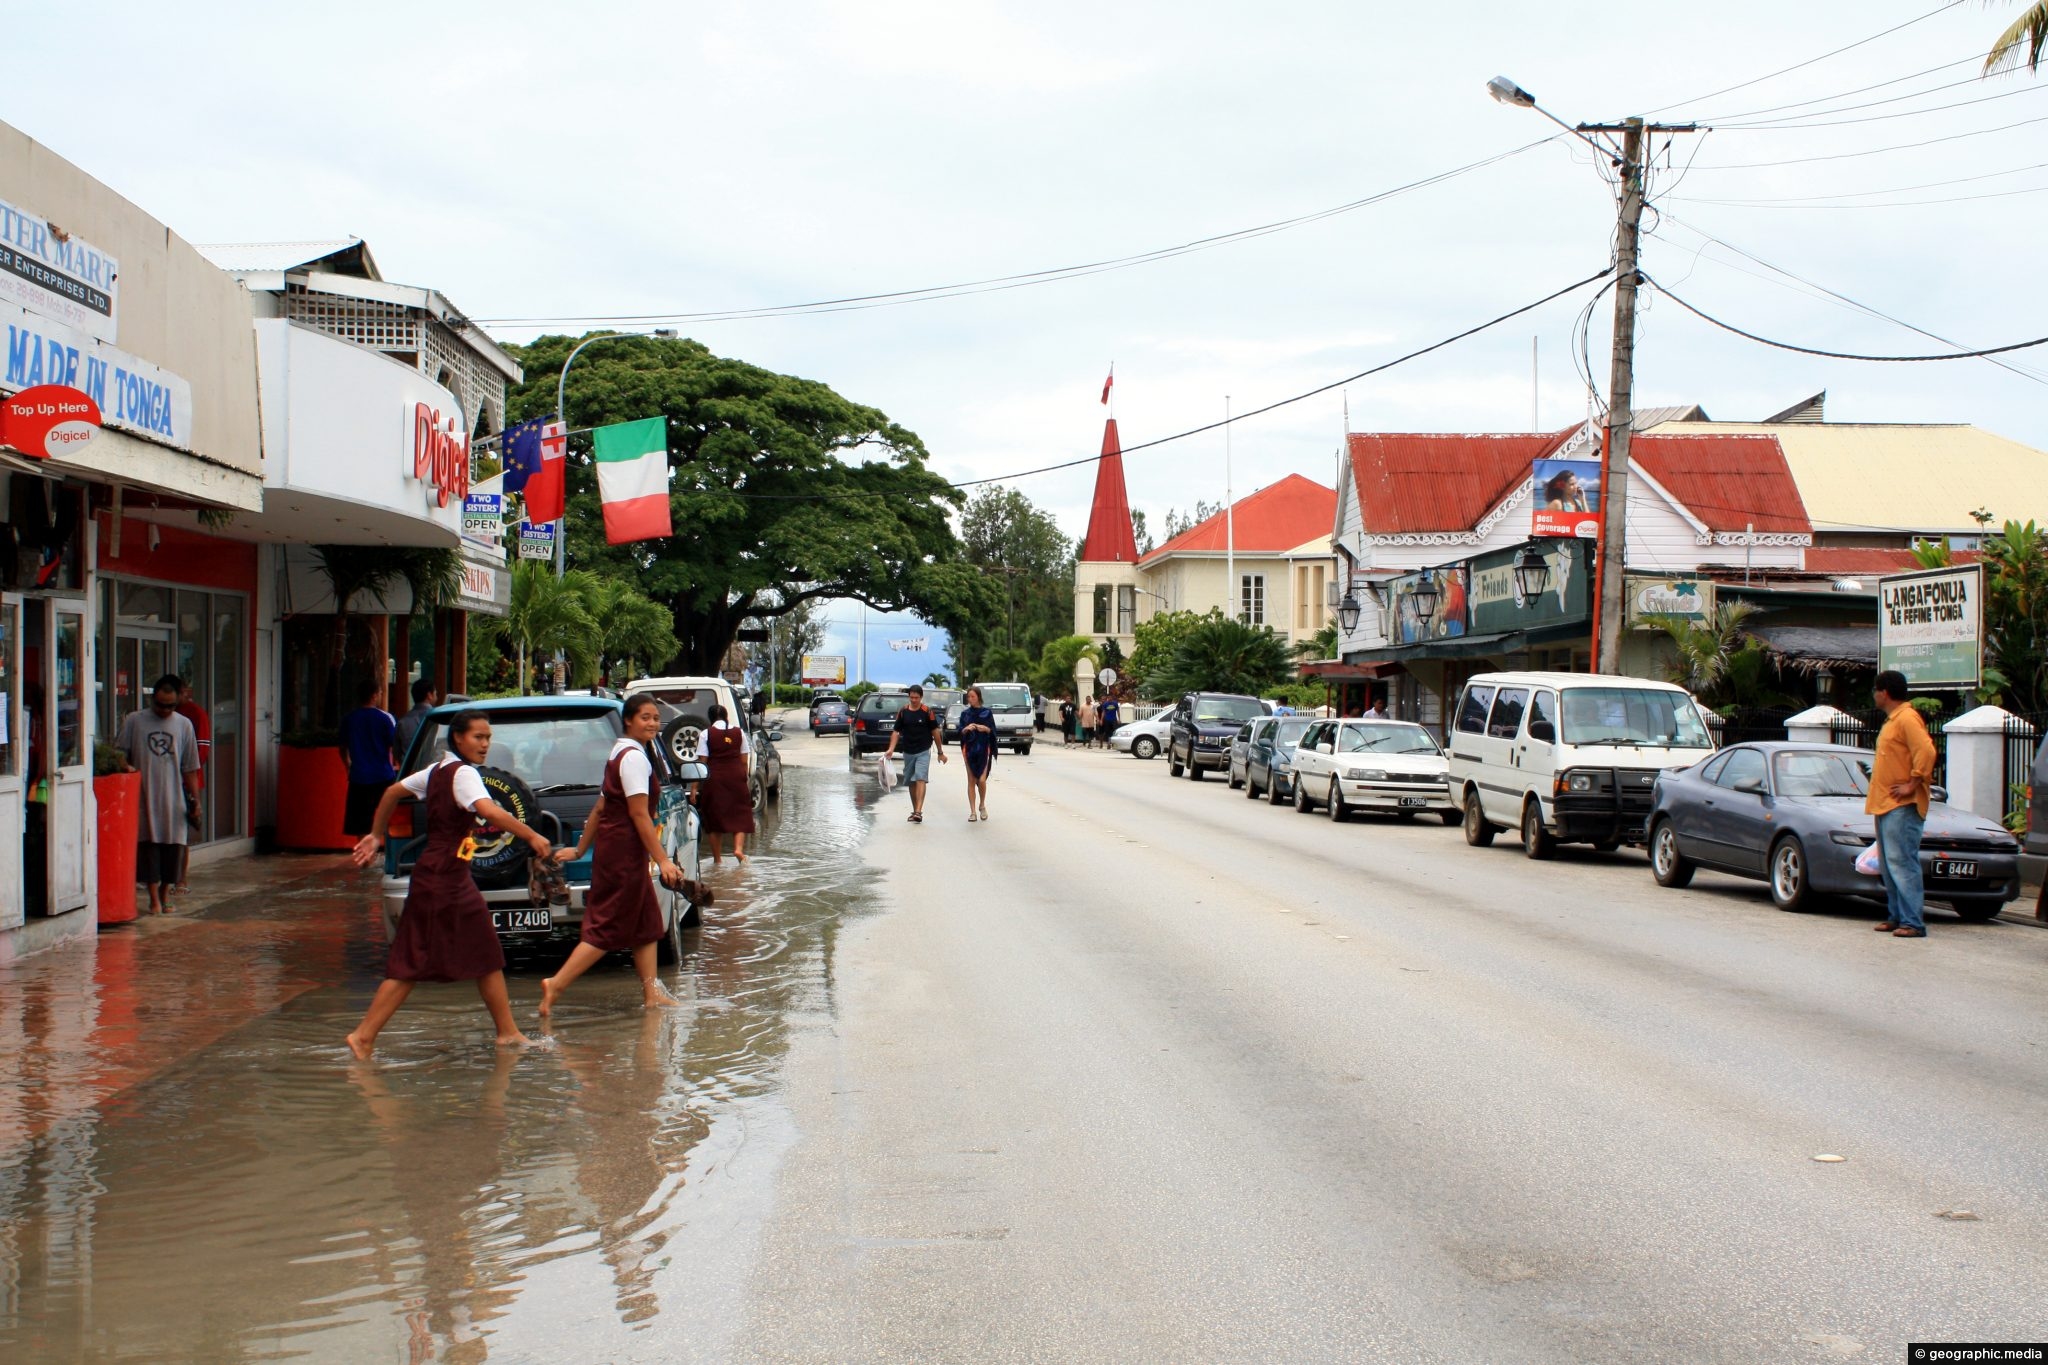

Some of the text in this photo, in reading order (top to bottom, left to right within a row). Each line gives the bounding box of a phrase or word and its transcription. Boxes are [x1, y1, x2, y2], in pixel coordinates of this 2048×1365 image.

[54, 240, 115, 292] MART
[15, 254, 85, 299] ENTERPRISES
[88, 289, 107, 310] LTD.
[6, 324, 174, 437] MADE IN TONGA
[11, 402, 89, 417] Top Up Here
[51, 430, 90, 444] Digicel
[414, 401, 469, 508] Digicel
[466, 503, 498, 513] SISTERS'
[472, 495, 491, 503] TWO
[465, 519, 497, 530] OPEN
[1536, 524, 1571, 533] Coverage
[521, 544, 549, 554] OPEN
[1481, 571, 1508, 599] Friends
[1884, 580, 1967, 609] LANGAFONUA
[1904, 607, 1932, 624] FEFINE
[1933, 604, 1963, 622] TONGA
[481, 776, 526, 823] EHICLE RUNNE
[475, 847, 515, 867] SUBISHI
[1936, 862, 1975, 875] C 8444
[492, 910, 549, 928] C 12408
